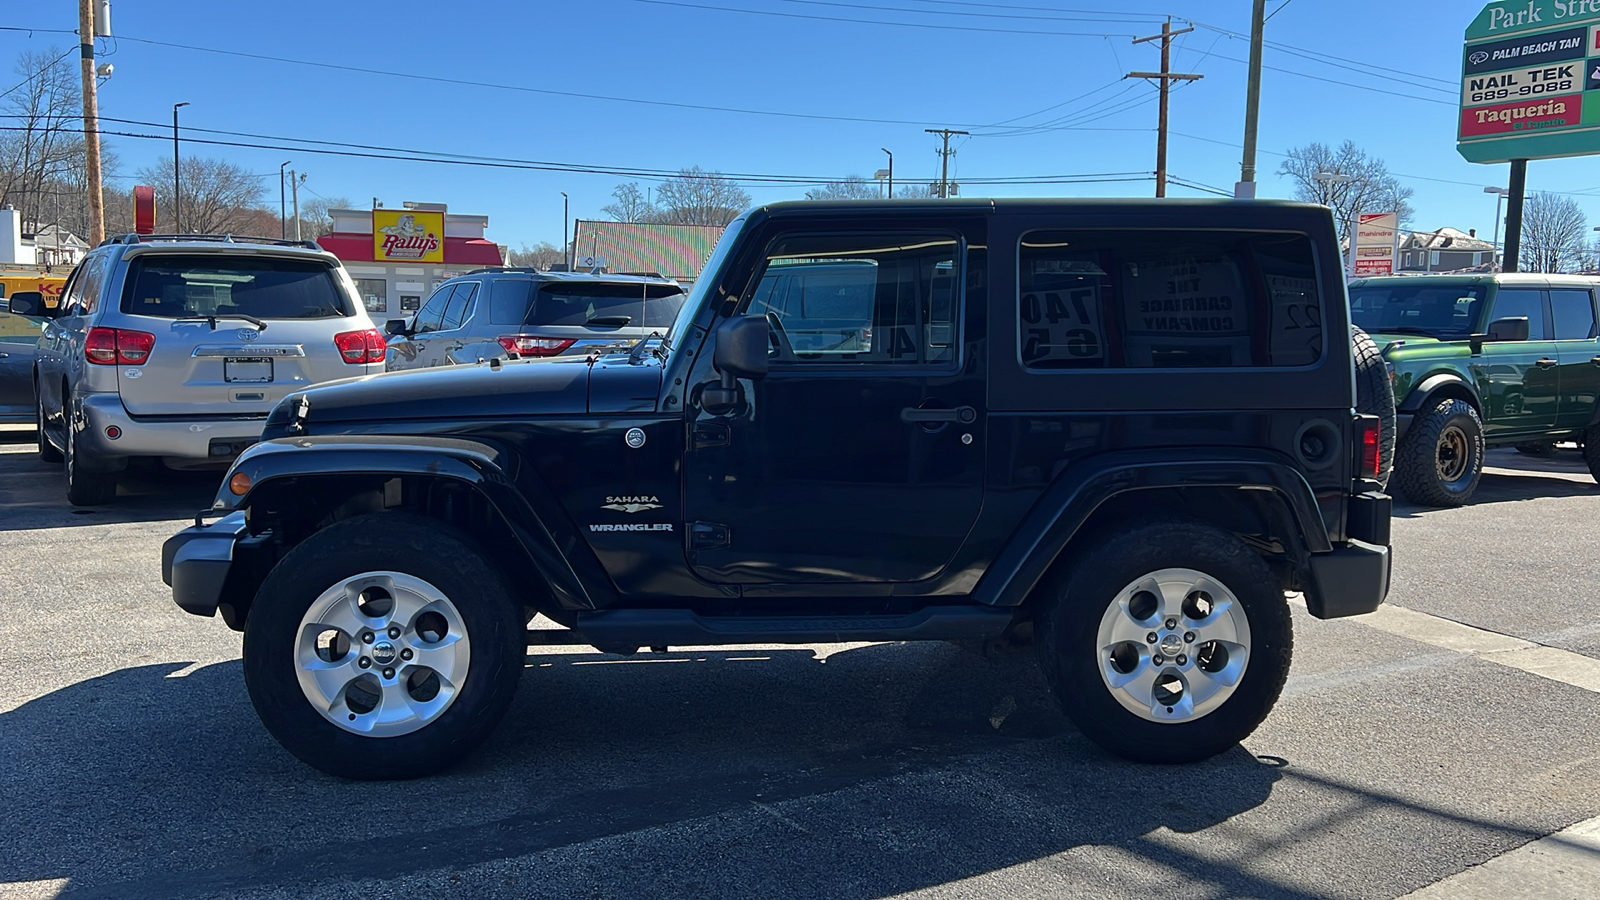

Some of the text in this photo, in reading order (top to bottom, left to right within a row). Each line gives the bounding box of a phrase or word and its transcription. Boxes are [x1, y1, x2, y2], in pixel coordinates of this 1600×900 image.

[1488, 0, 1542, 30] Park
[1492, 37, 1581, 61] PALM BEACH TAN
[1470, 65, 1574, 92] NAIL TEK
[1471, 80, 1572, 102] 689-9088
[381, 233, 439, 257] Rally's
[605, 495, 659, 503] SAHARA
[589, 523, 674, 532] WRANGLER
